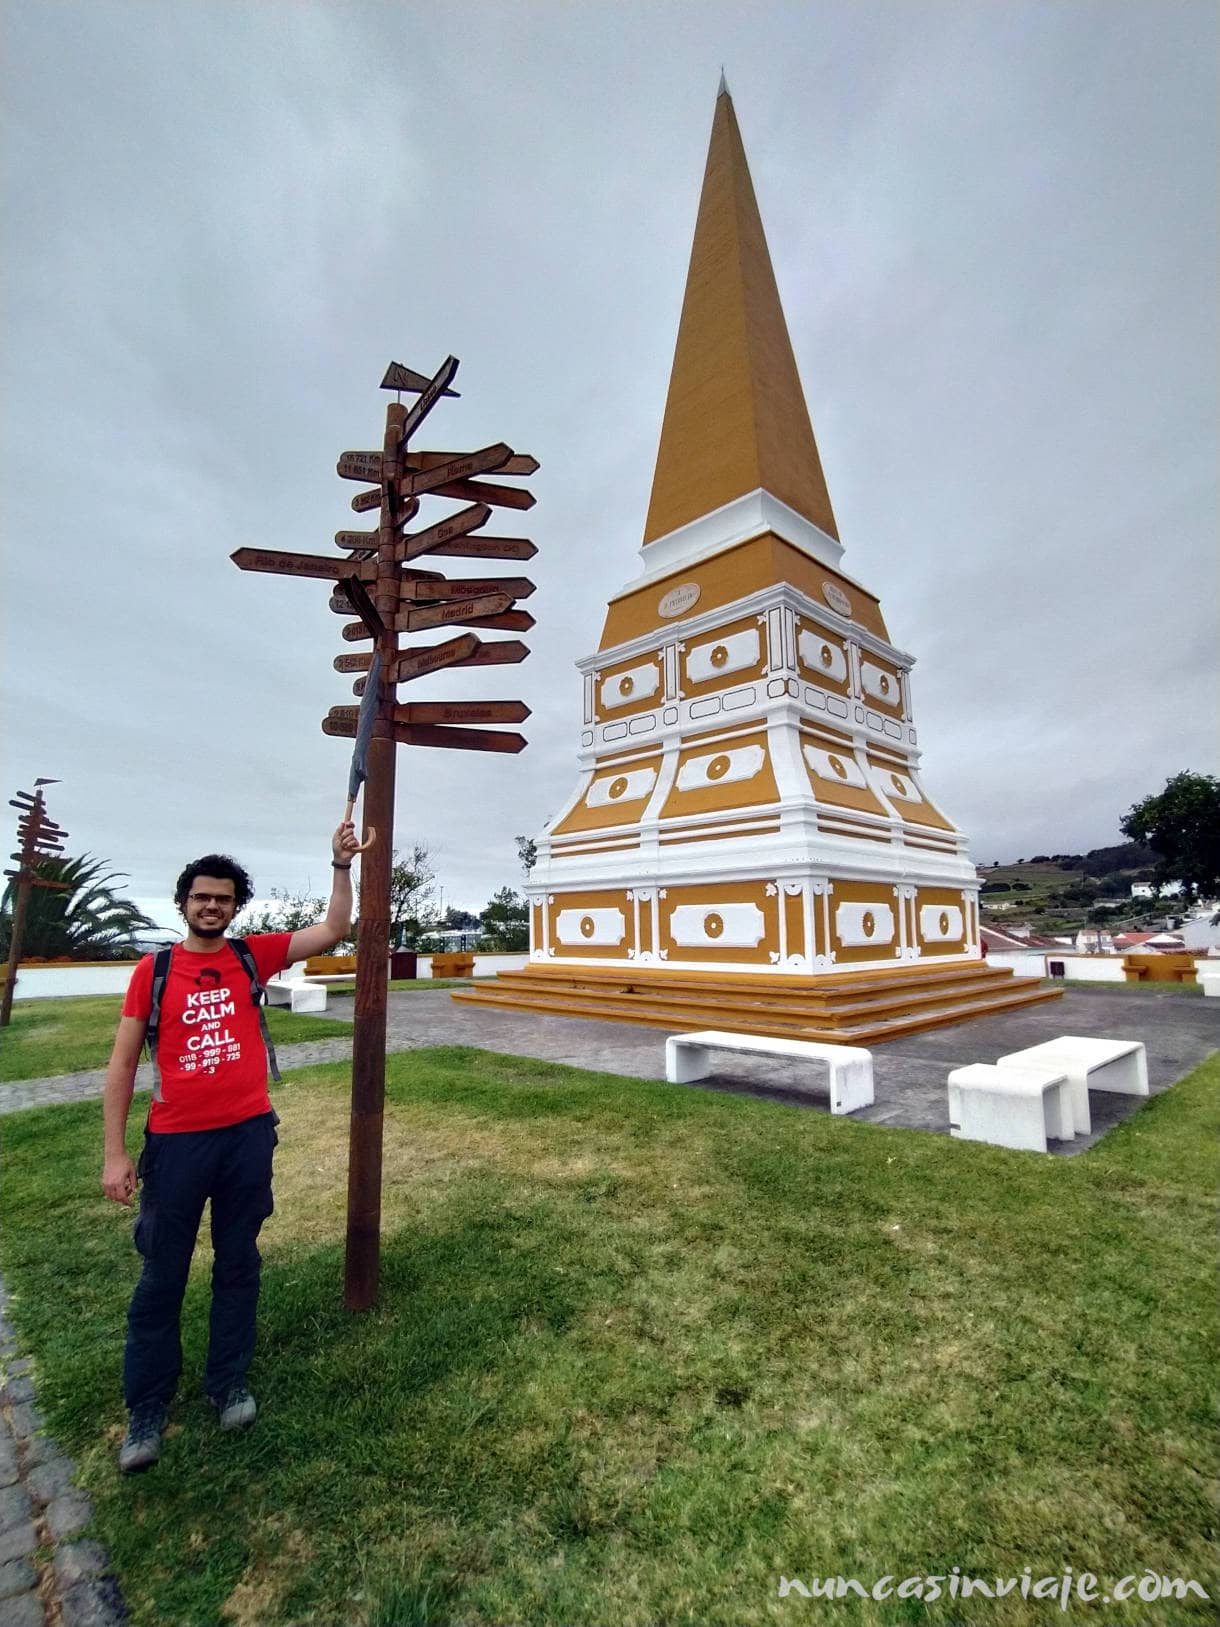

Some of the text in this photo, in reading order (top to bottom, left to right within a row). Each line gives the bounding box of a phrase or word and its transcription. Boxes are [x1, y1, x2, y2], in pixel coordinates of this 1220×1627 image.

[442, 602, 474, 619] Madrid
[186, 987, 231, 1008] KEEP
[182, 1001, 235, 1024] CALM
[200, 1021, 221, 1032] AND
[187, 1029, 235, 1051] CALL
[178, 1053, 197, 1063] 0118
[203, 1048, 221, 1058] 999
[185, 1062, 196, 1071] 99
[202, 1056, 220, 1067] 9119
[226, 1052, 241, 1062] 725
[208, 1066, 216, 1074] 3
